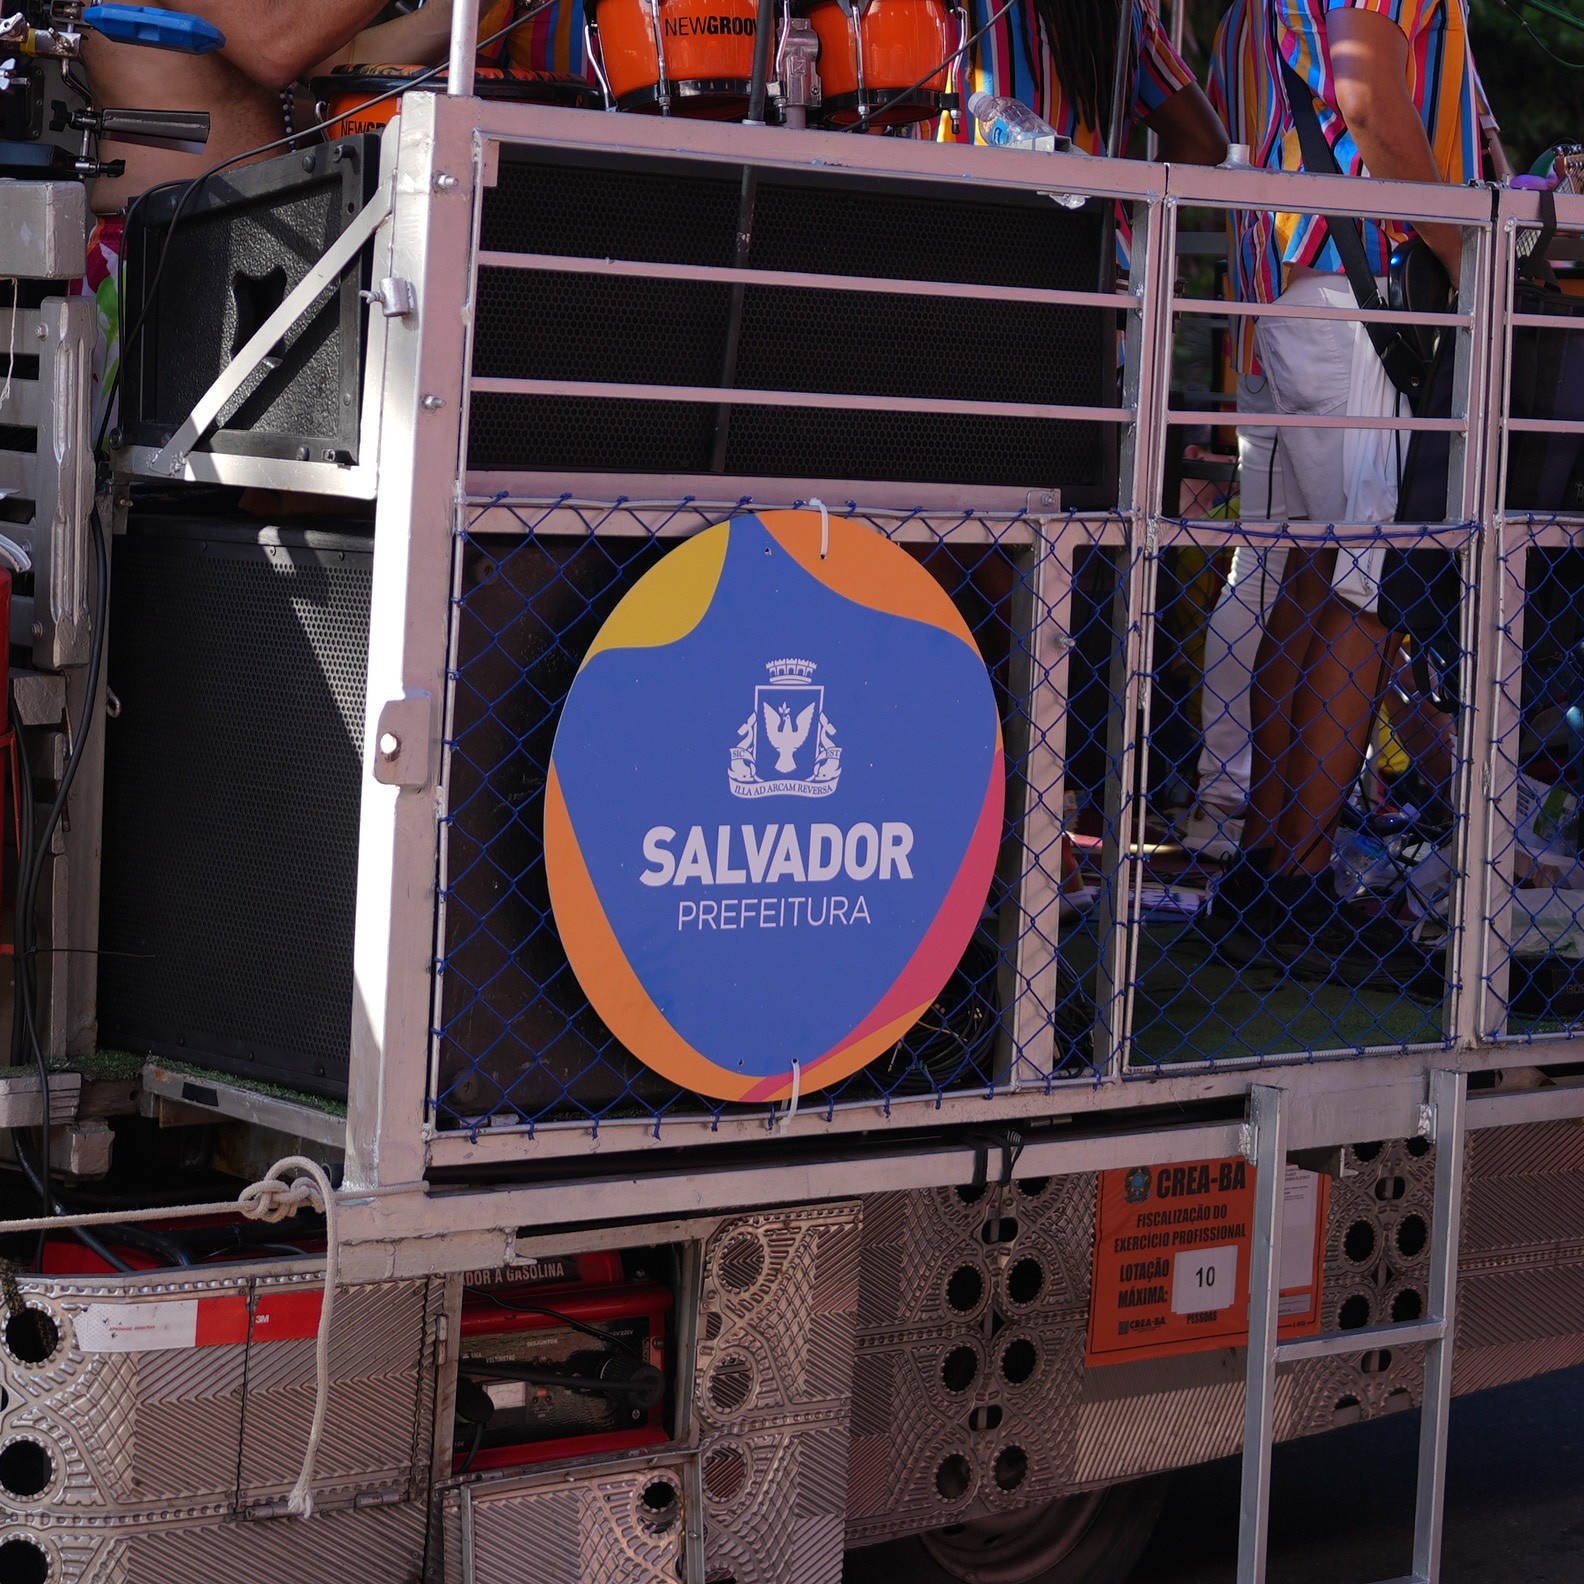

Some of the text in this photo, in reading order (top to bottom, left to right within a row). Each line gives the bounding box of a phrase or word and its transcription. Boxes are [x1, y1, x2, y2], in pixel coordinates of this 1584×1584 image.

[732, 749, 745, 758] SIC
[734, 782, 833, 796] ILLA AD ARCAM REVERSA
[638, 821, 915, 888] SALVADOR
[677, 895, 873, 932] PREFEITURA
[1156, 1160, 1246, 1199] CREA-BA
[1136, 1204, 1228, 1228] FISCALIZAÇÃO DO
[1114, 1223, 1247, 1254] EXERCÍCIO PROFISSIONAL
[461, 1272, 490, 1287] DOR
[506, 1262, 565, 1282] GASOLINA
[1119, 1257, 1170, 1283] LOTAÇÃO
[1195, 1266, 1216, 1288] 10
[1118, 1283, 1168, 1308] MÁXIMA:
[254, 1313, 270, 1324] 3M
[1130, 1316, 1166, 1330] CREA-BA
[1186, 1310, 1218, 1325] PESSOAS
